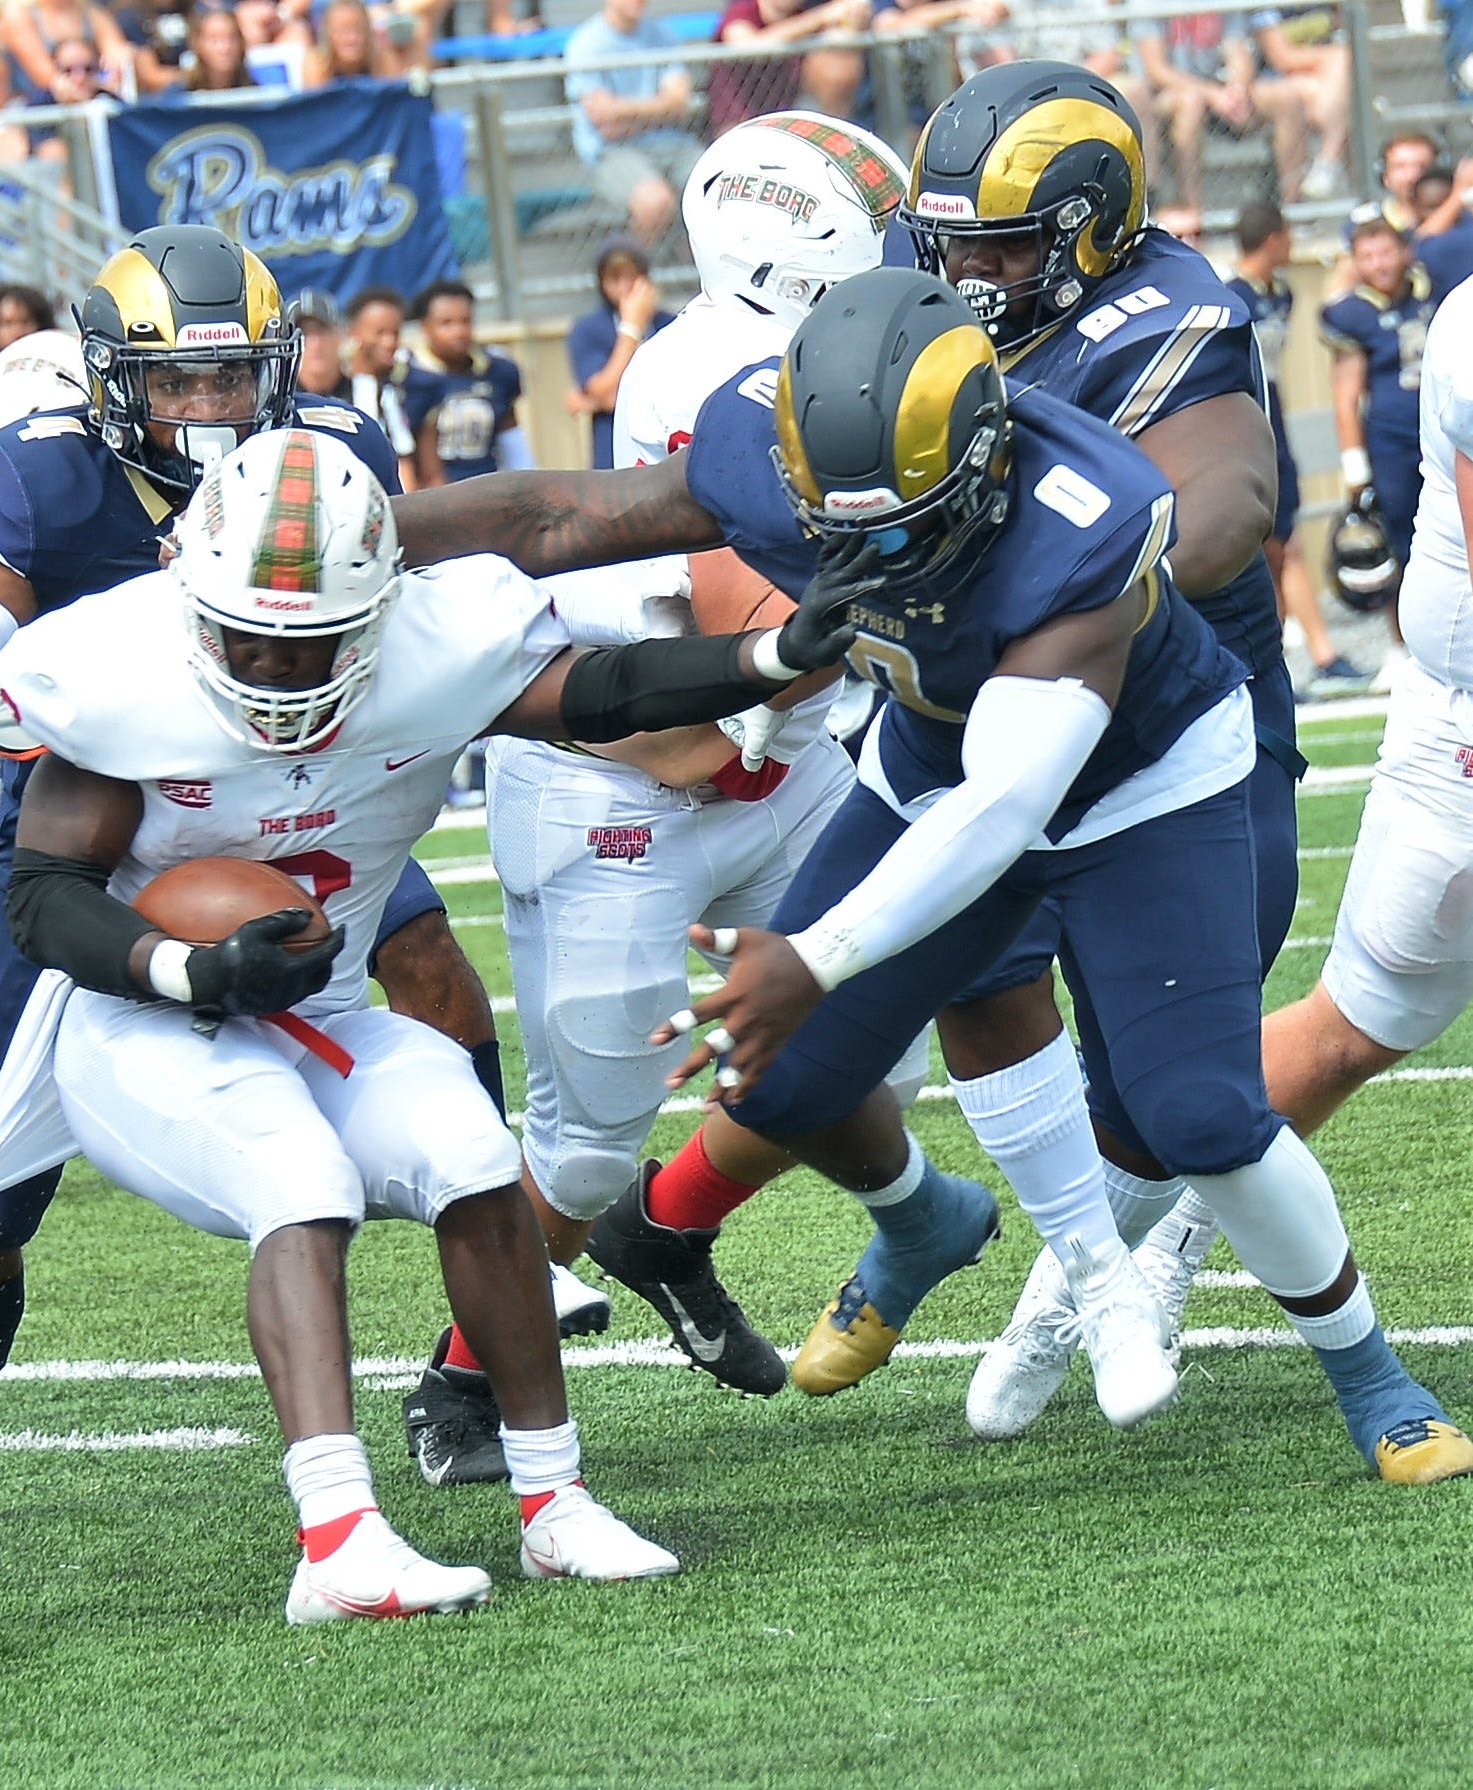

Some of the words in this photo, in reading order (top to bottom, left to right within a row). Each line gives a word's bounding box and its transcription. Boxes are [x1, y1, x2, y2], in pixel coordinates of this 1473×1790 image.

[146, 121, 419, 256] Rams
[717, 174, 761, 211] THE
[756, 178, 821, 226] BORO
[920, 198, 965, 214] Riddell
[187, 327, 241, 341] Riddell
[1032, 463, 1112, 529] 0
[846, 603, 906, 641] EPHERD
[258, 818, 291, 838] THE
[294, 808, 338, 832] BORO
